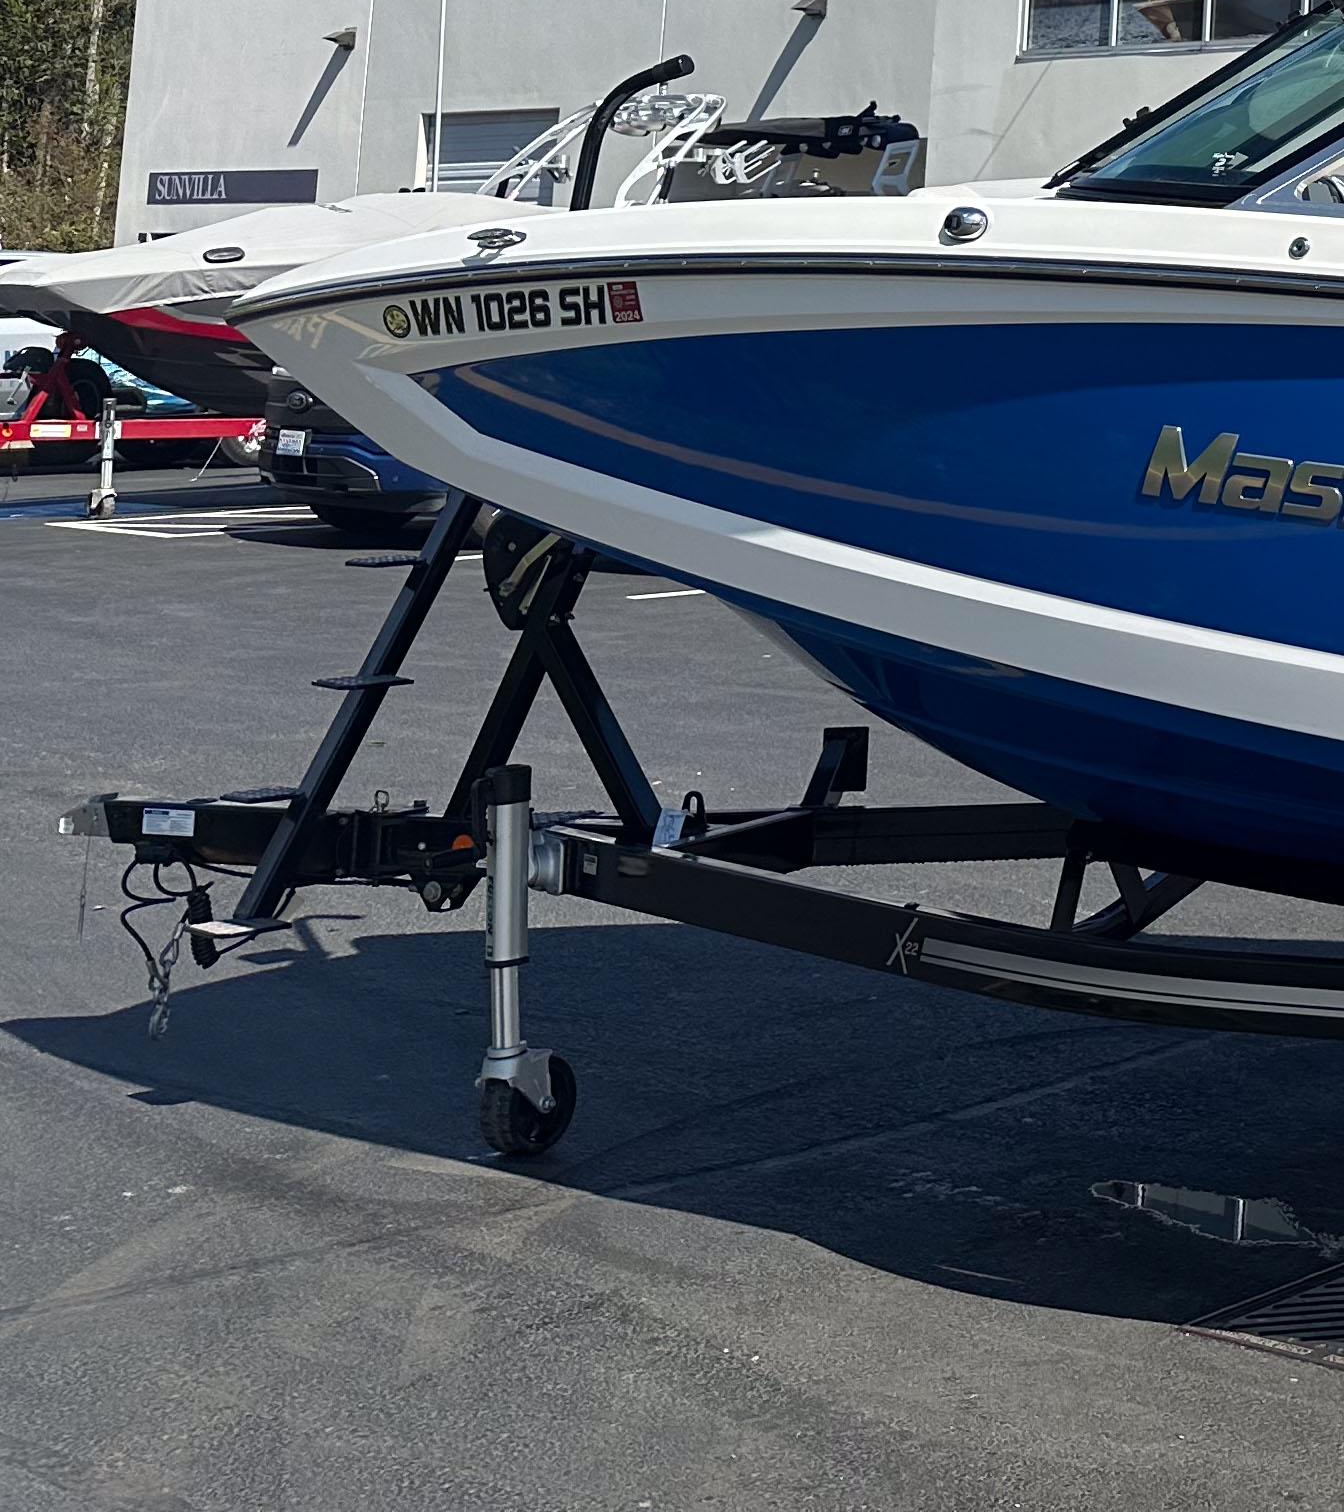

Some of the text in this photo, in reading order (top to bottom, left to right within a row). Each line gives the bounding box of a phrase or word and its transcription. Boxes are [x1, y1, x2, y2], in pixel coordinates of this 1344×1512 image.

[154, 174, 227, 200] SUNVILLA
[408, 295, 465, 336] WN
[470, 289, 551, 332] 1026
[558, 285, 607, 326] SH
[614, 309, 641, 322] 2024
